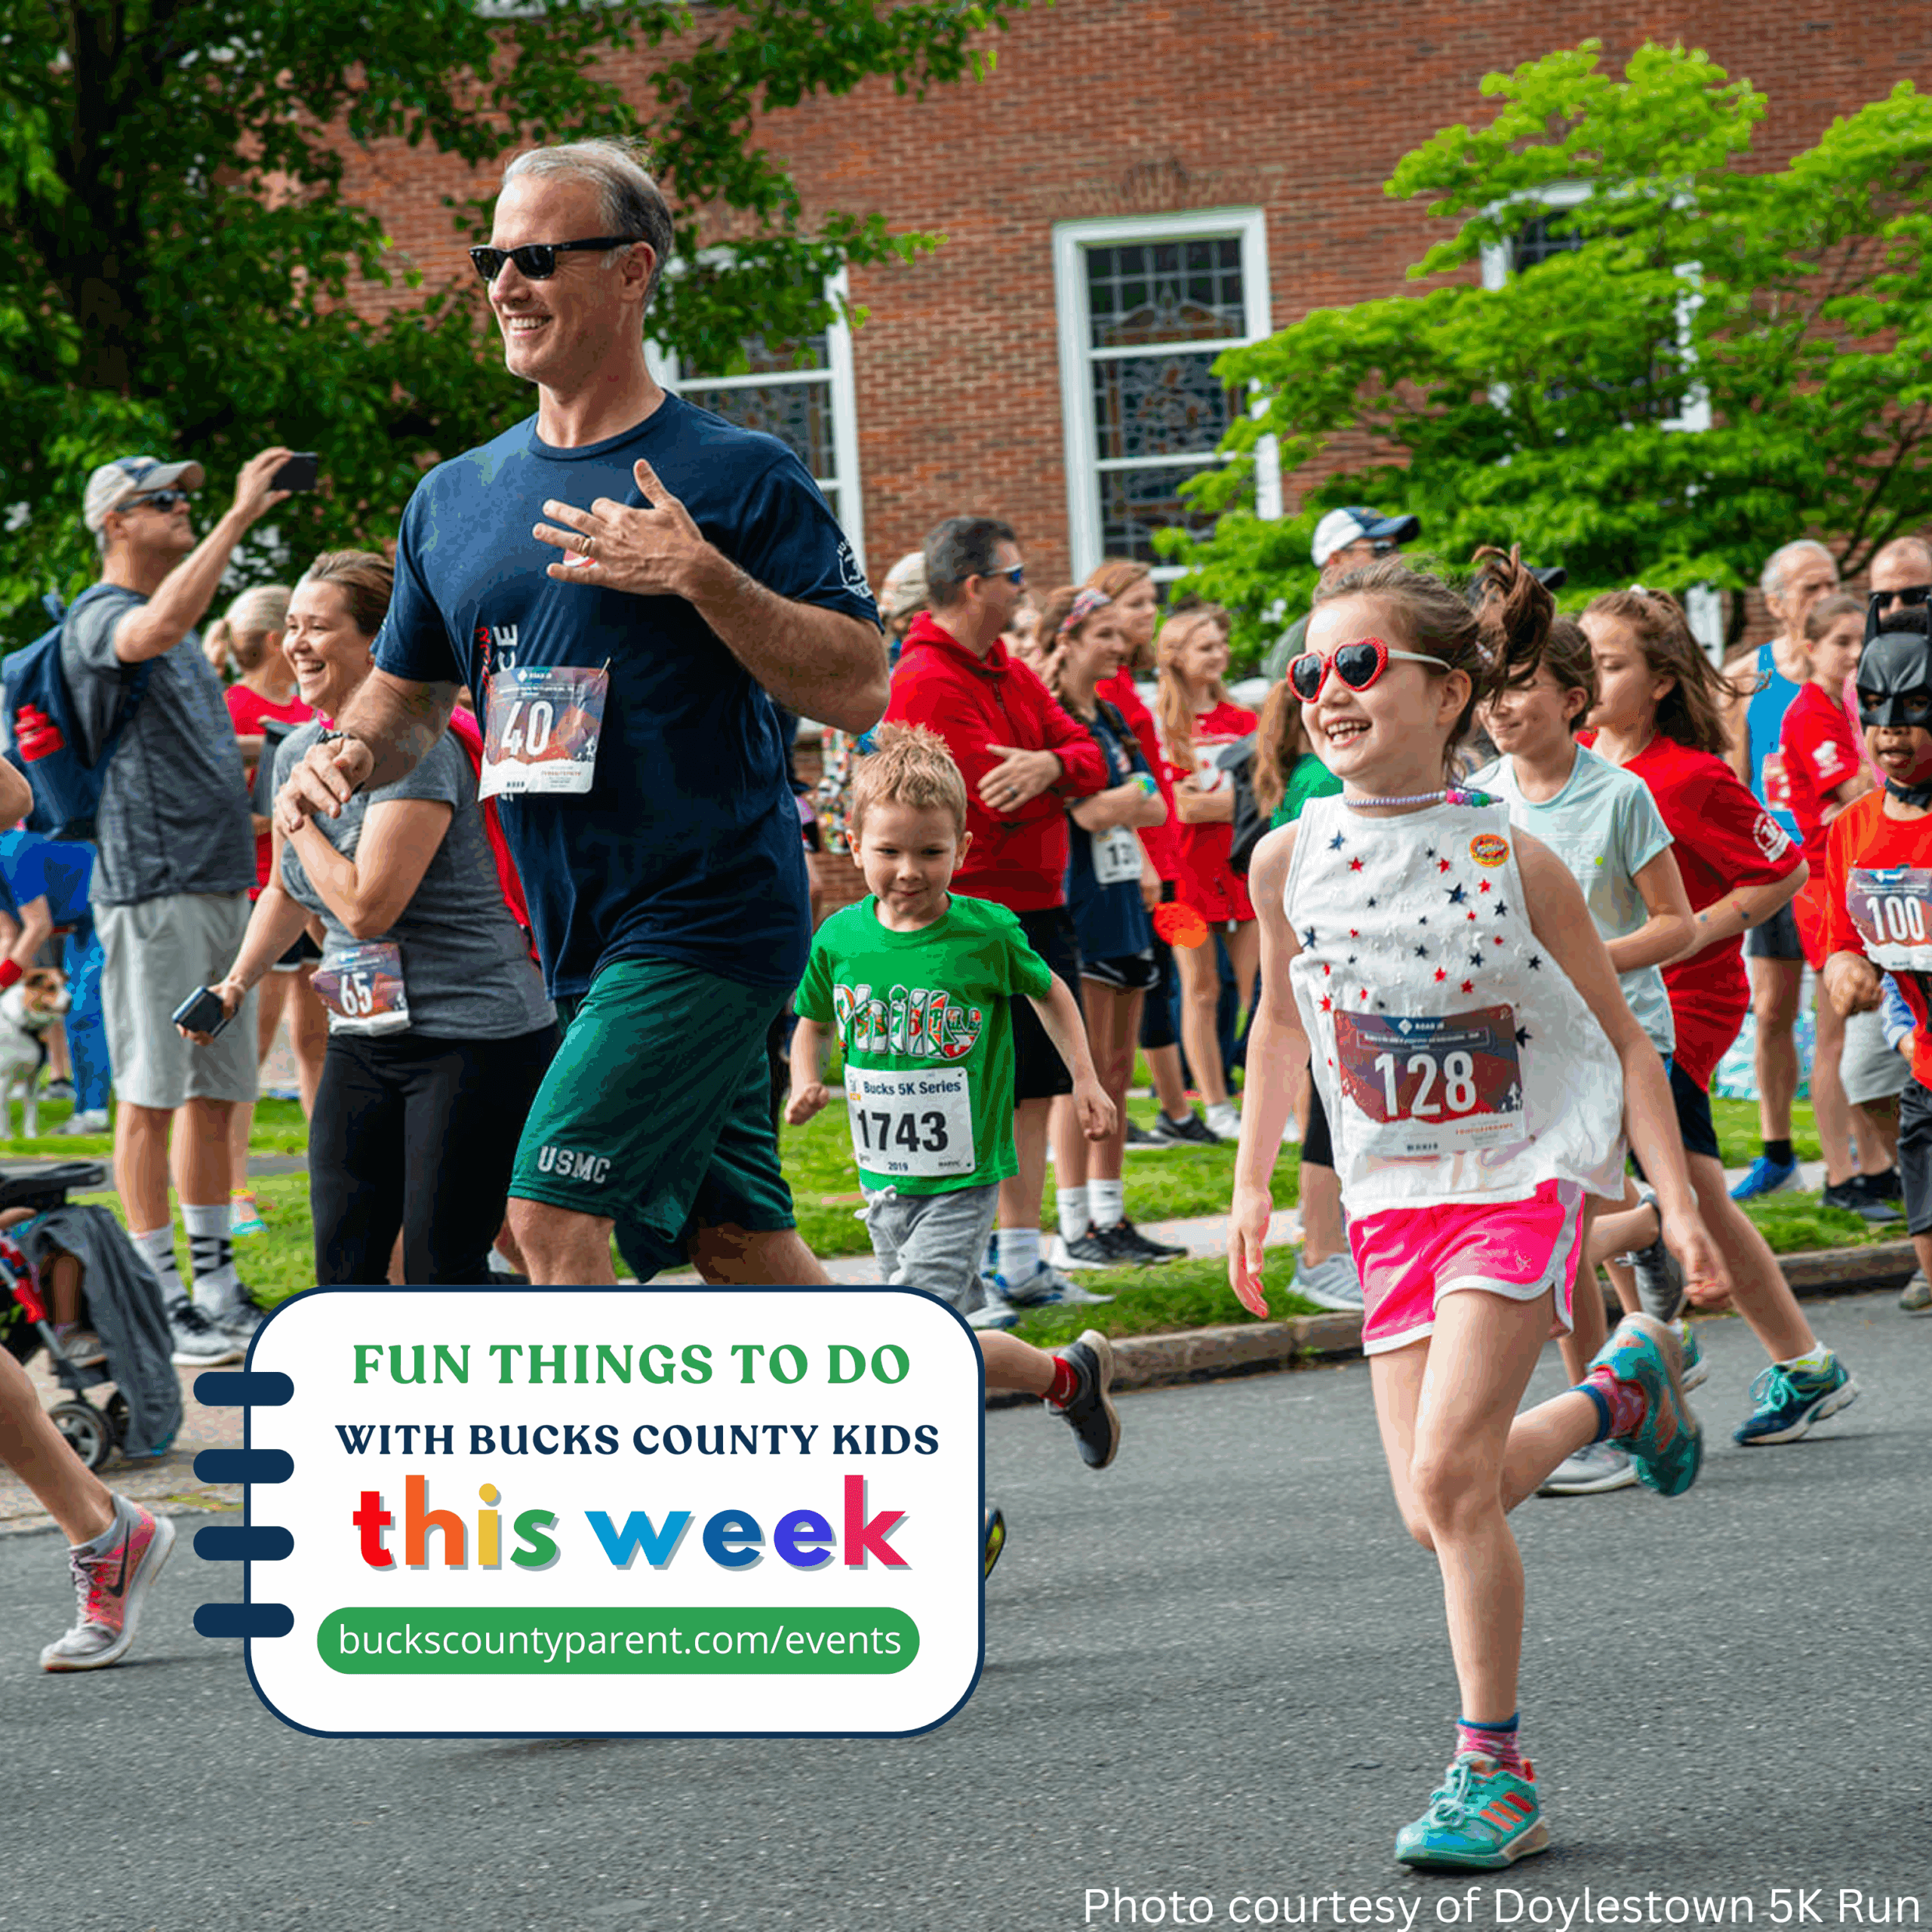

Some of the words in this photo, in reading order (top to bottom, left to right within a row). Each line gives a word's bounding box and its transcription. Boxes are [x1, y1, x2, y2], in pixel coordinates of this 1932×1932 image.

[500, 700, 554, 756] 40
[1866, 896, 1925, 942] 100
[340, 972, 374, 1016] 65
[863, 1081, 896, 1096] Bucks
[898, 1081, 916, 1095] 5K
[918, 1079, 961, 1094] Series
[1374, 1050, 1478, 1118] 128
[857, 1109, 949, 1153] 1743
[537, 1146, 611, 1184] USMC
